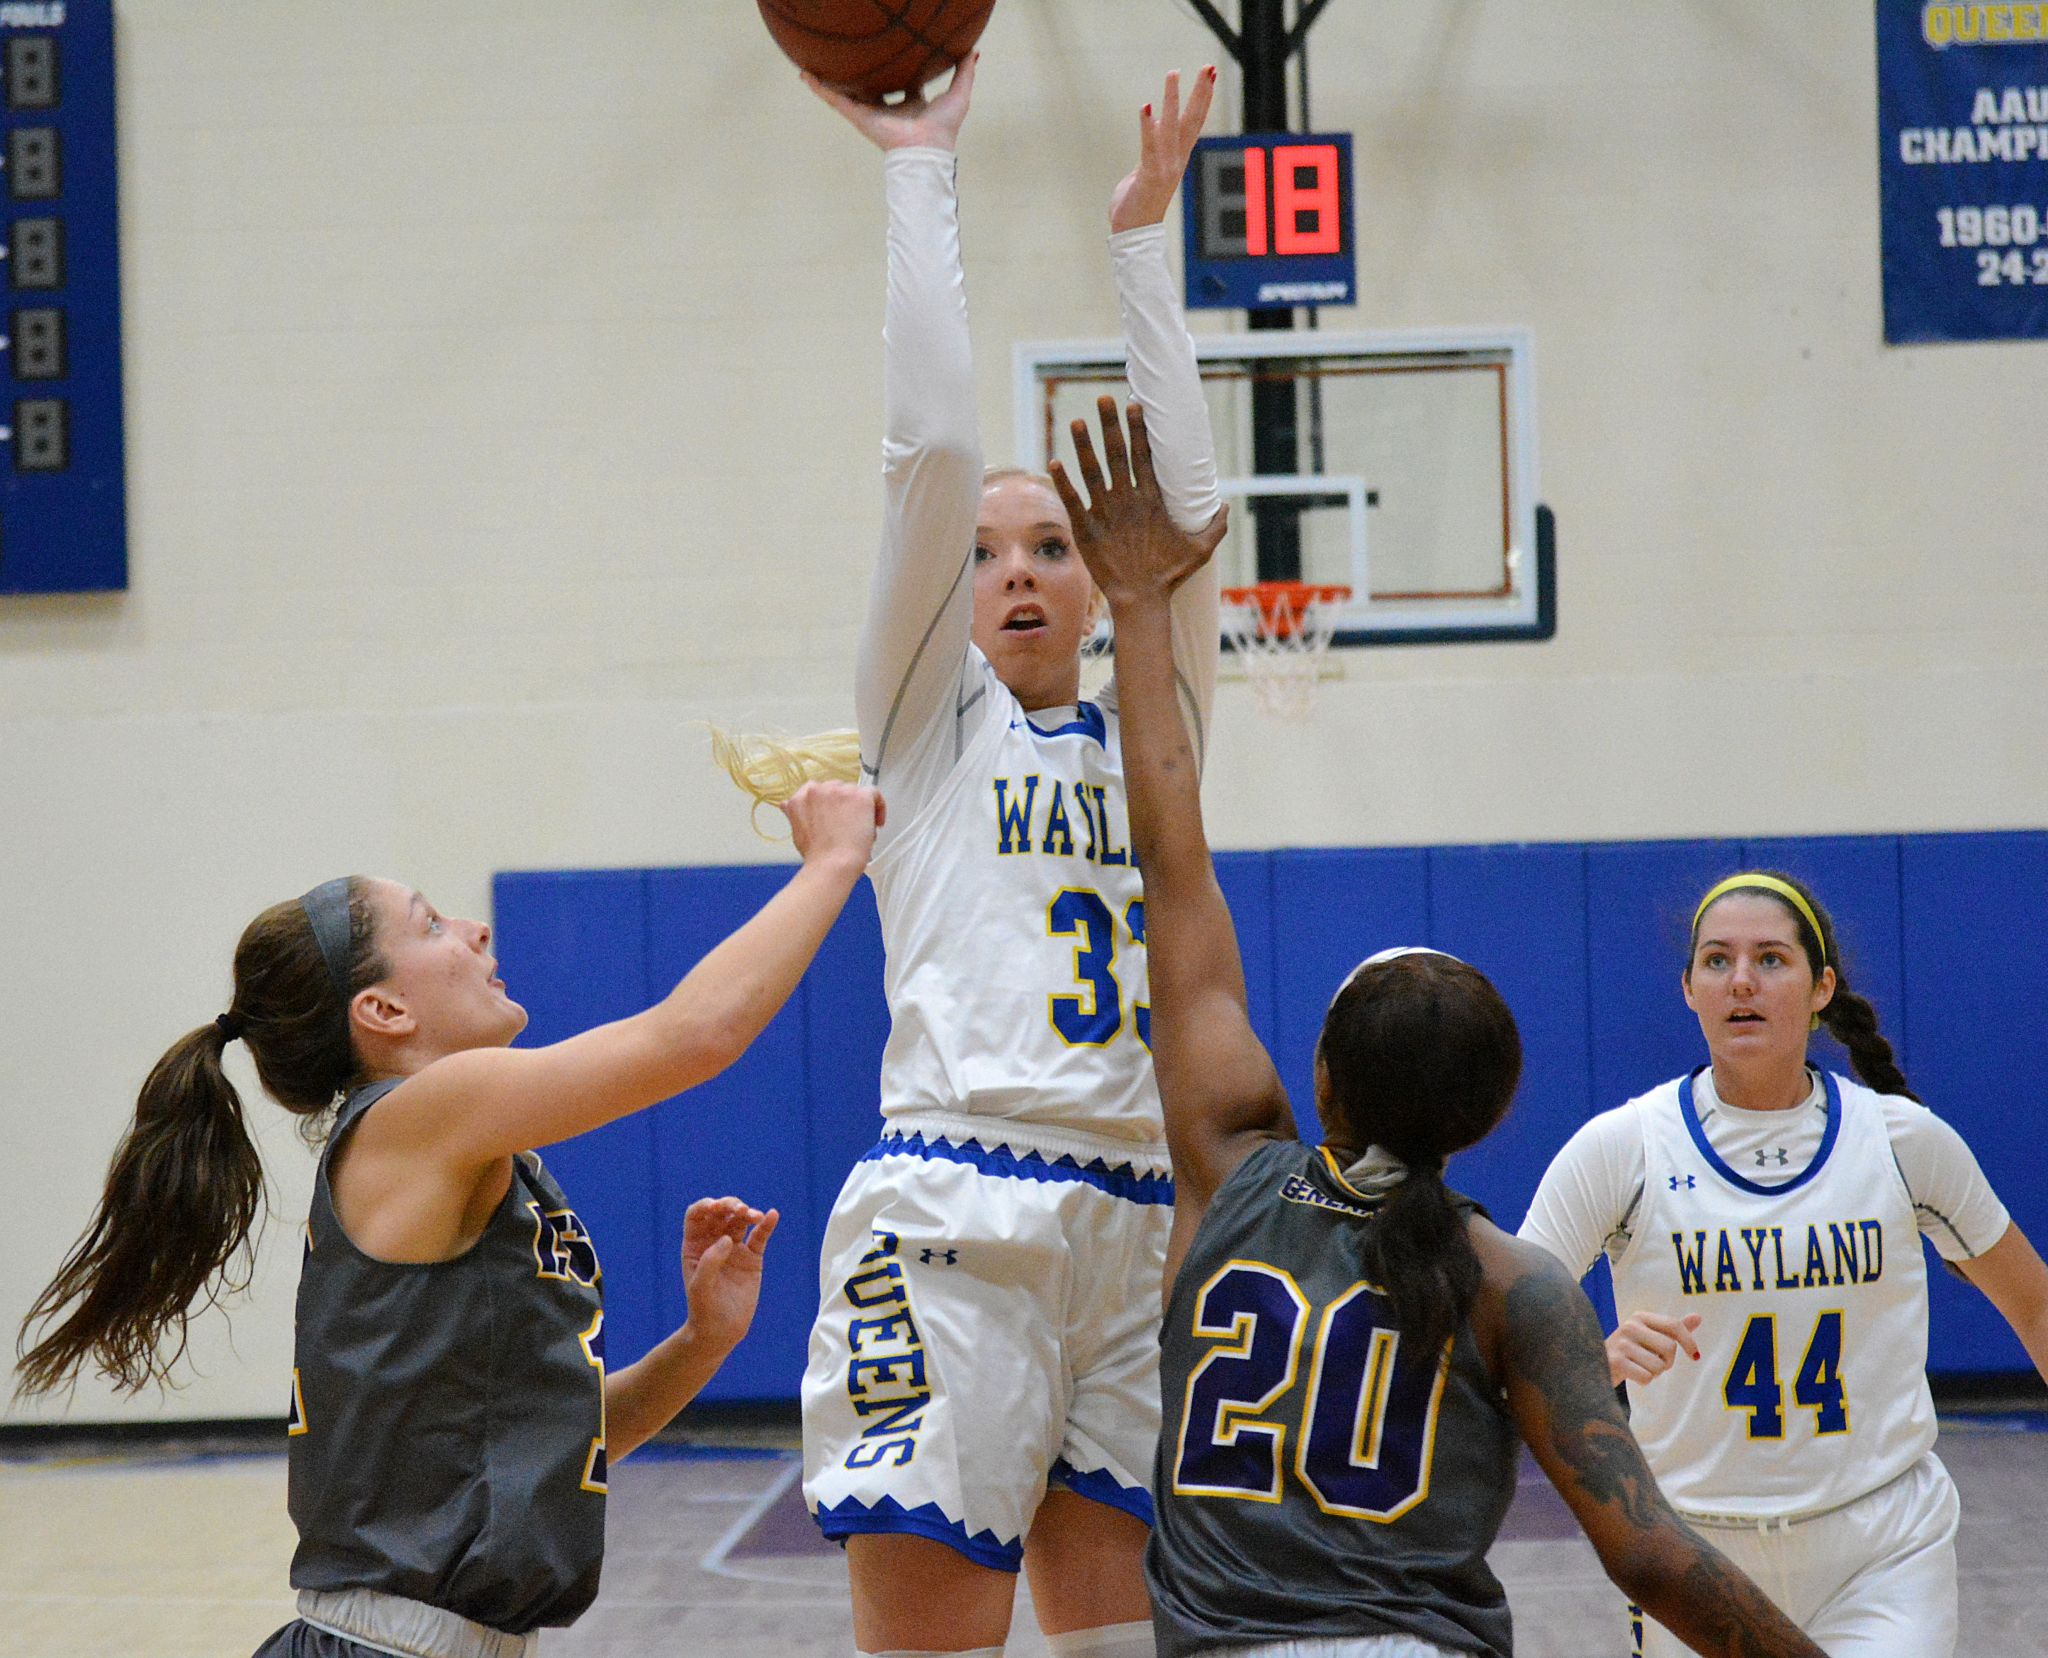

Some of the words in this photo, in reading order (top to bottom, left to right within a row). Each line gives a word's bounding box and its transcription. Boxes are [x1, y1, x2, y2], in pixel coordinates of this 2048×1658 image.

[1971, 86, 2048, 124] AAU
[1244, 145, 1340, 256] 18
[1936, 204, 2048, 248] 1960-
[993, 773, 1140, 868] WAYL
[1671, 1217, 1883, 1296] WAYLAND
[1173, 1258, 1455, 1524] 20
[1721, 1307, 1852, 1441] 44
